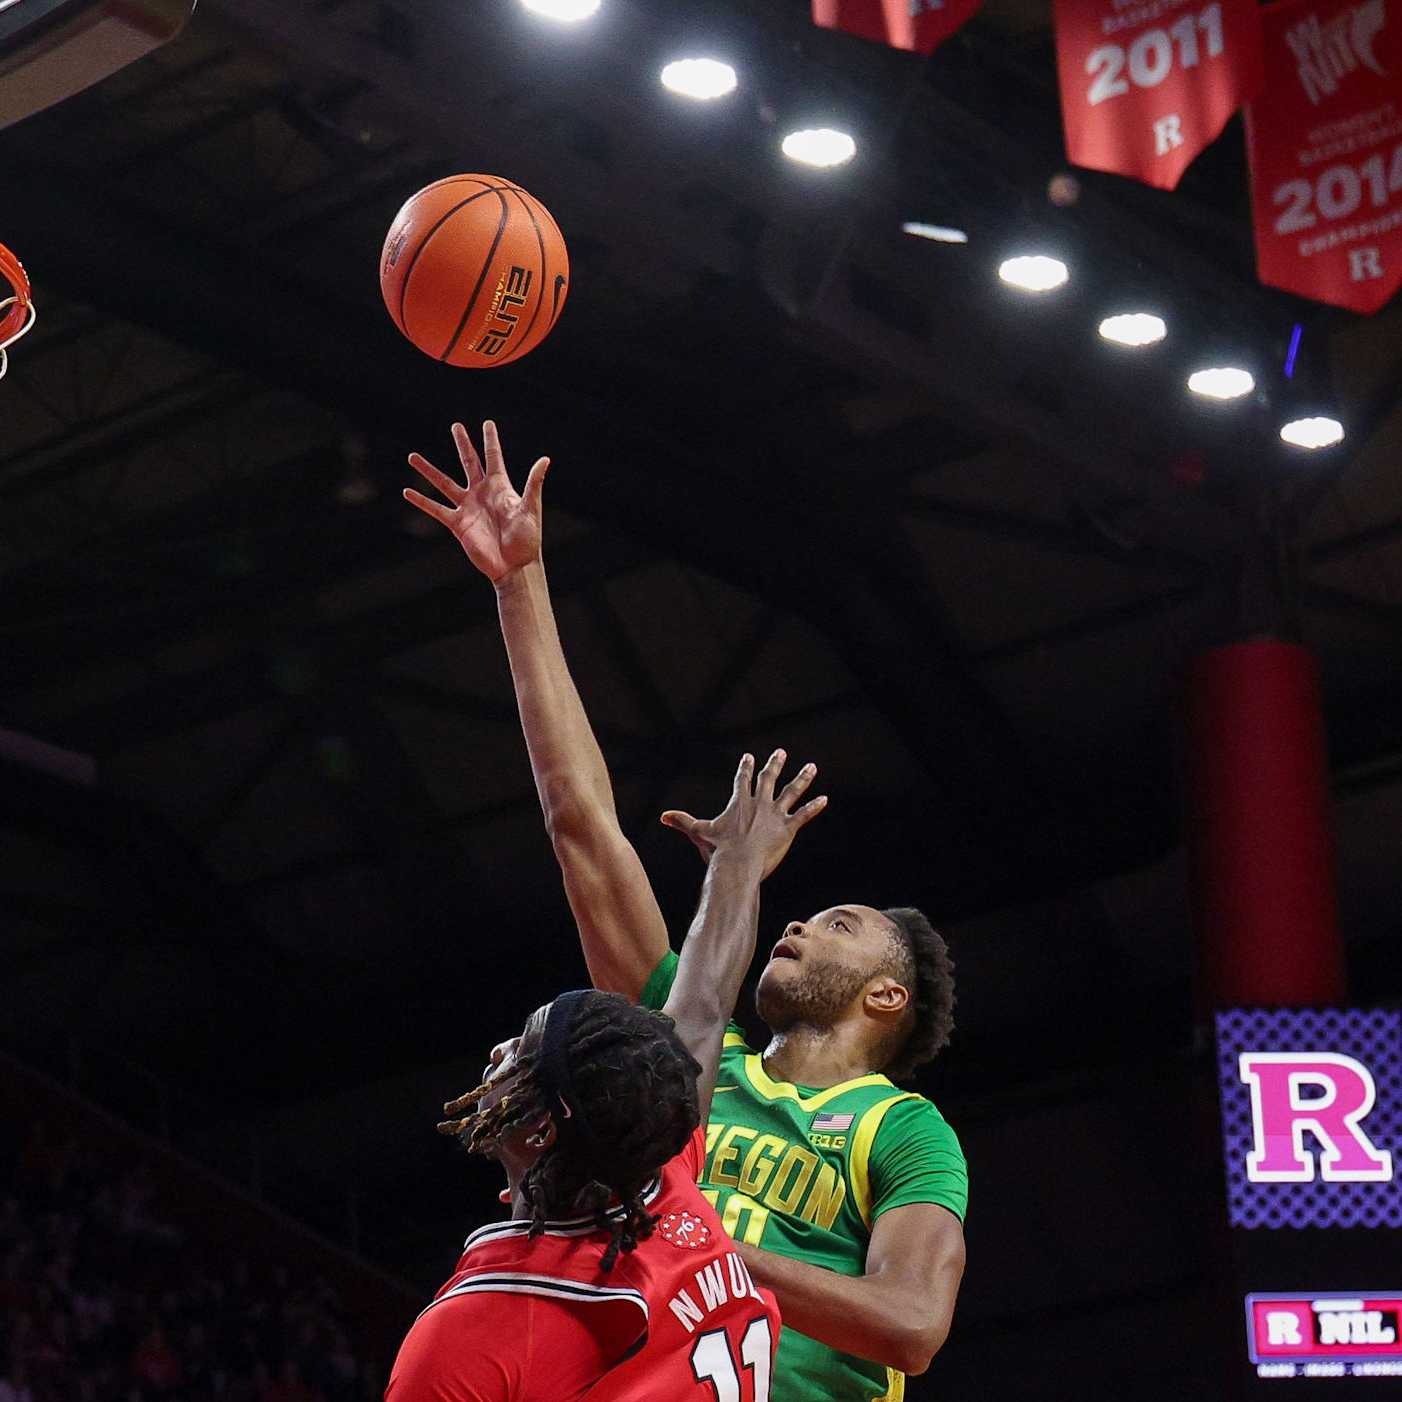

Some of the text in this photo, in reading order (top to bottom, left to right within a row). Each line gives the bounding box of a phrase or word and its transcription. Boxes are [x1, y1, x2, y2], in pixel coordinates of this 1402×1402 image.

[1085, 5, 1224, 107] 2011
[1153, 114, 1185, 156] R
[1348, 247, 1385, 282] R
[1239, 1051, 1394, 1183] R
[675, 1215, 696, 1242] 76
[1265, 1311, 1303, 1346] R
